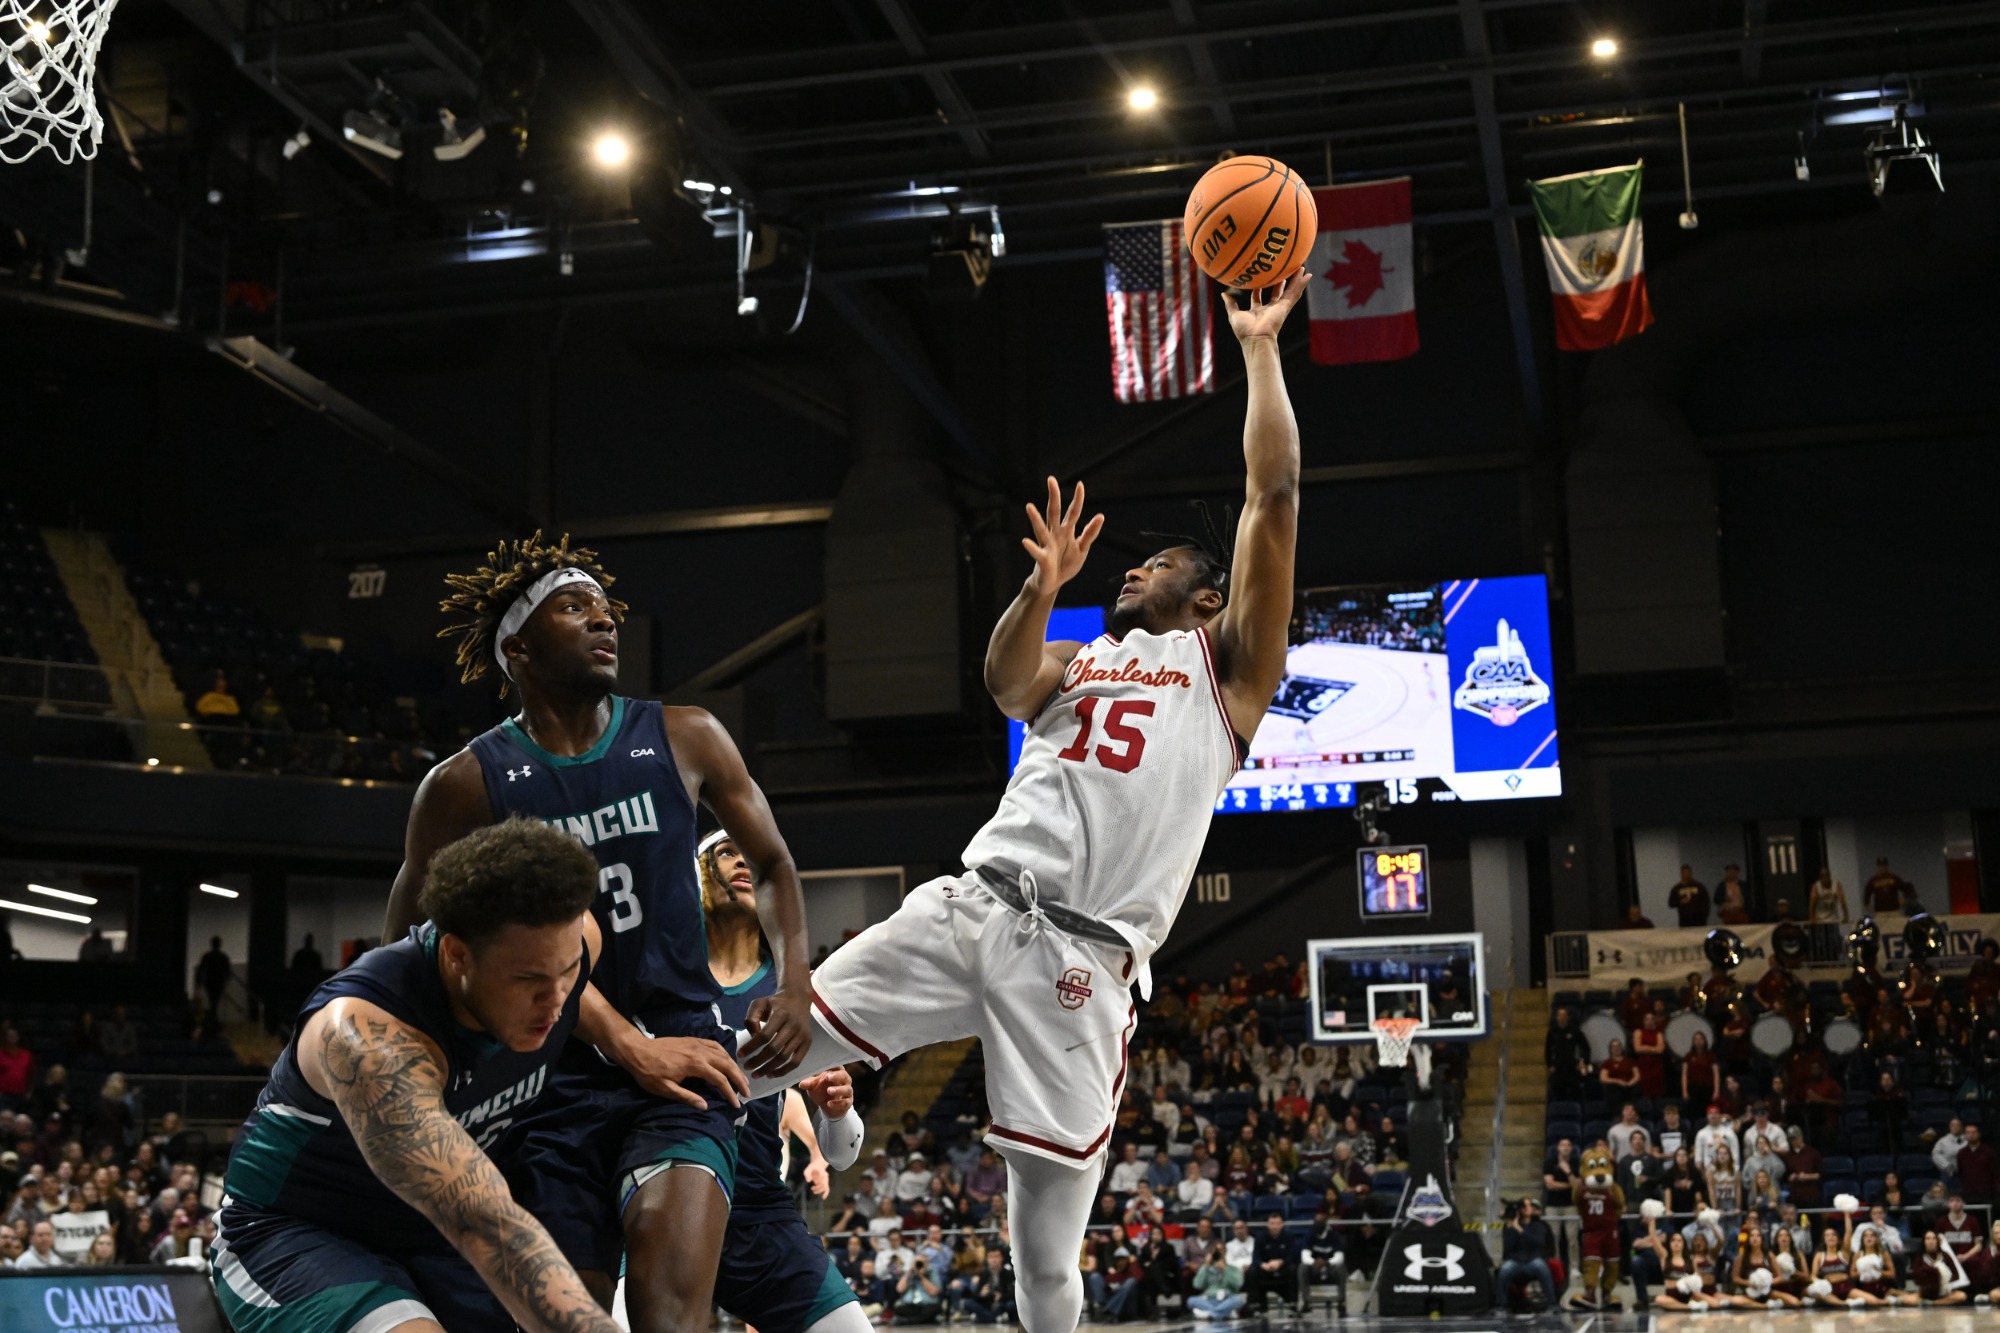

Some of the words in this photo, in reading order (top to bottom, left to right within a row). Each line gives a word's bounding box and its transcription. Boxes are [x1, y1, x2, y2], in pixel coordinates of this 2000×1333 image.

[1232, 226, 1290, 287] Wilson
[349, 570, 386, 598] 207
[1059, 656, 1192, 695] Charleston
[1473, 662, 1527, 681] CAA
[1057, 695, 1157, 774] 15
[630, 747, 656, 758] CAA
[1260, 783, 1303, 801] 8:44
[1384, 777, 1418, 804] 15
[1377, 853, 1421, 876] 8:43
[1769, 844, 1797, 874] 111
[1197, 873, 1231, 902] 110
[1386, 874, 1417, 909] 17
[1888, 931, 1976, 958] FILY
[1058, 982, 1091, 996] CHARLESTON
[45, 1284, 177, 1328] CAMERON
